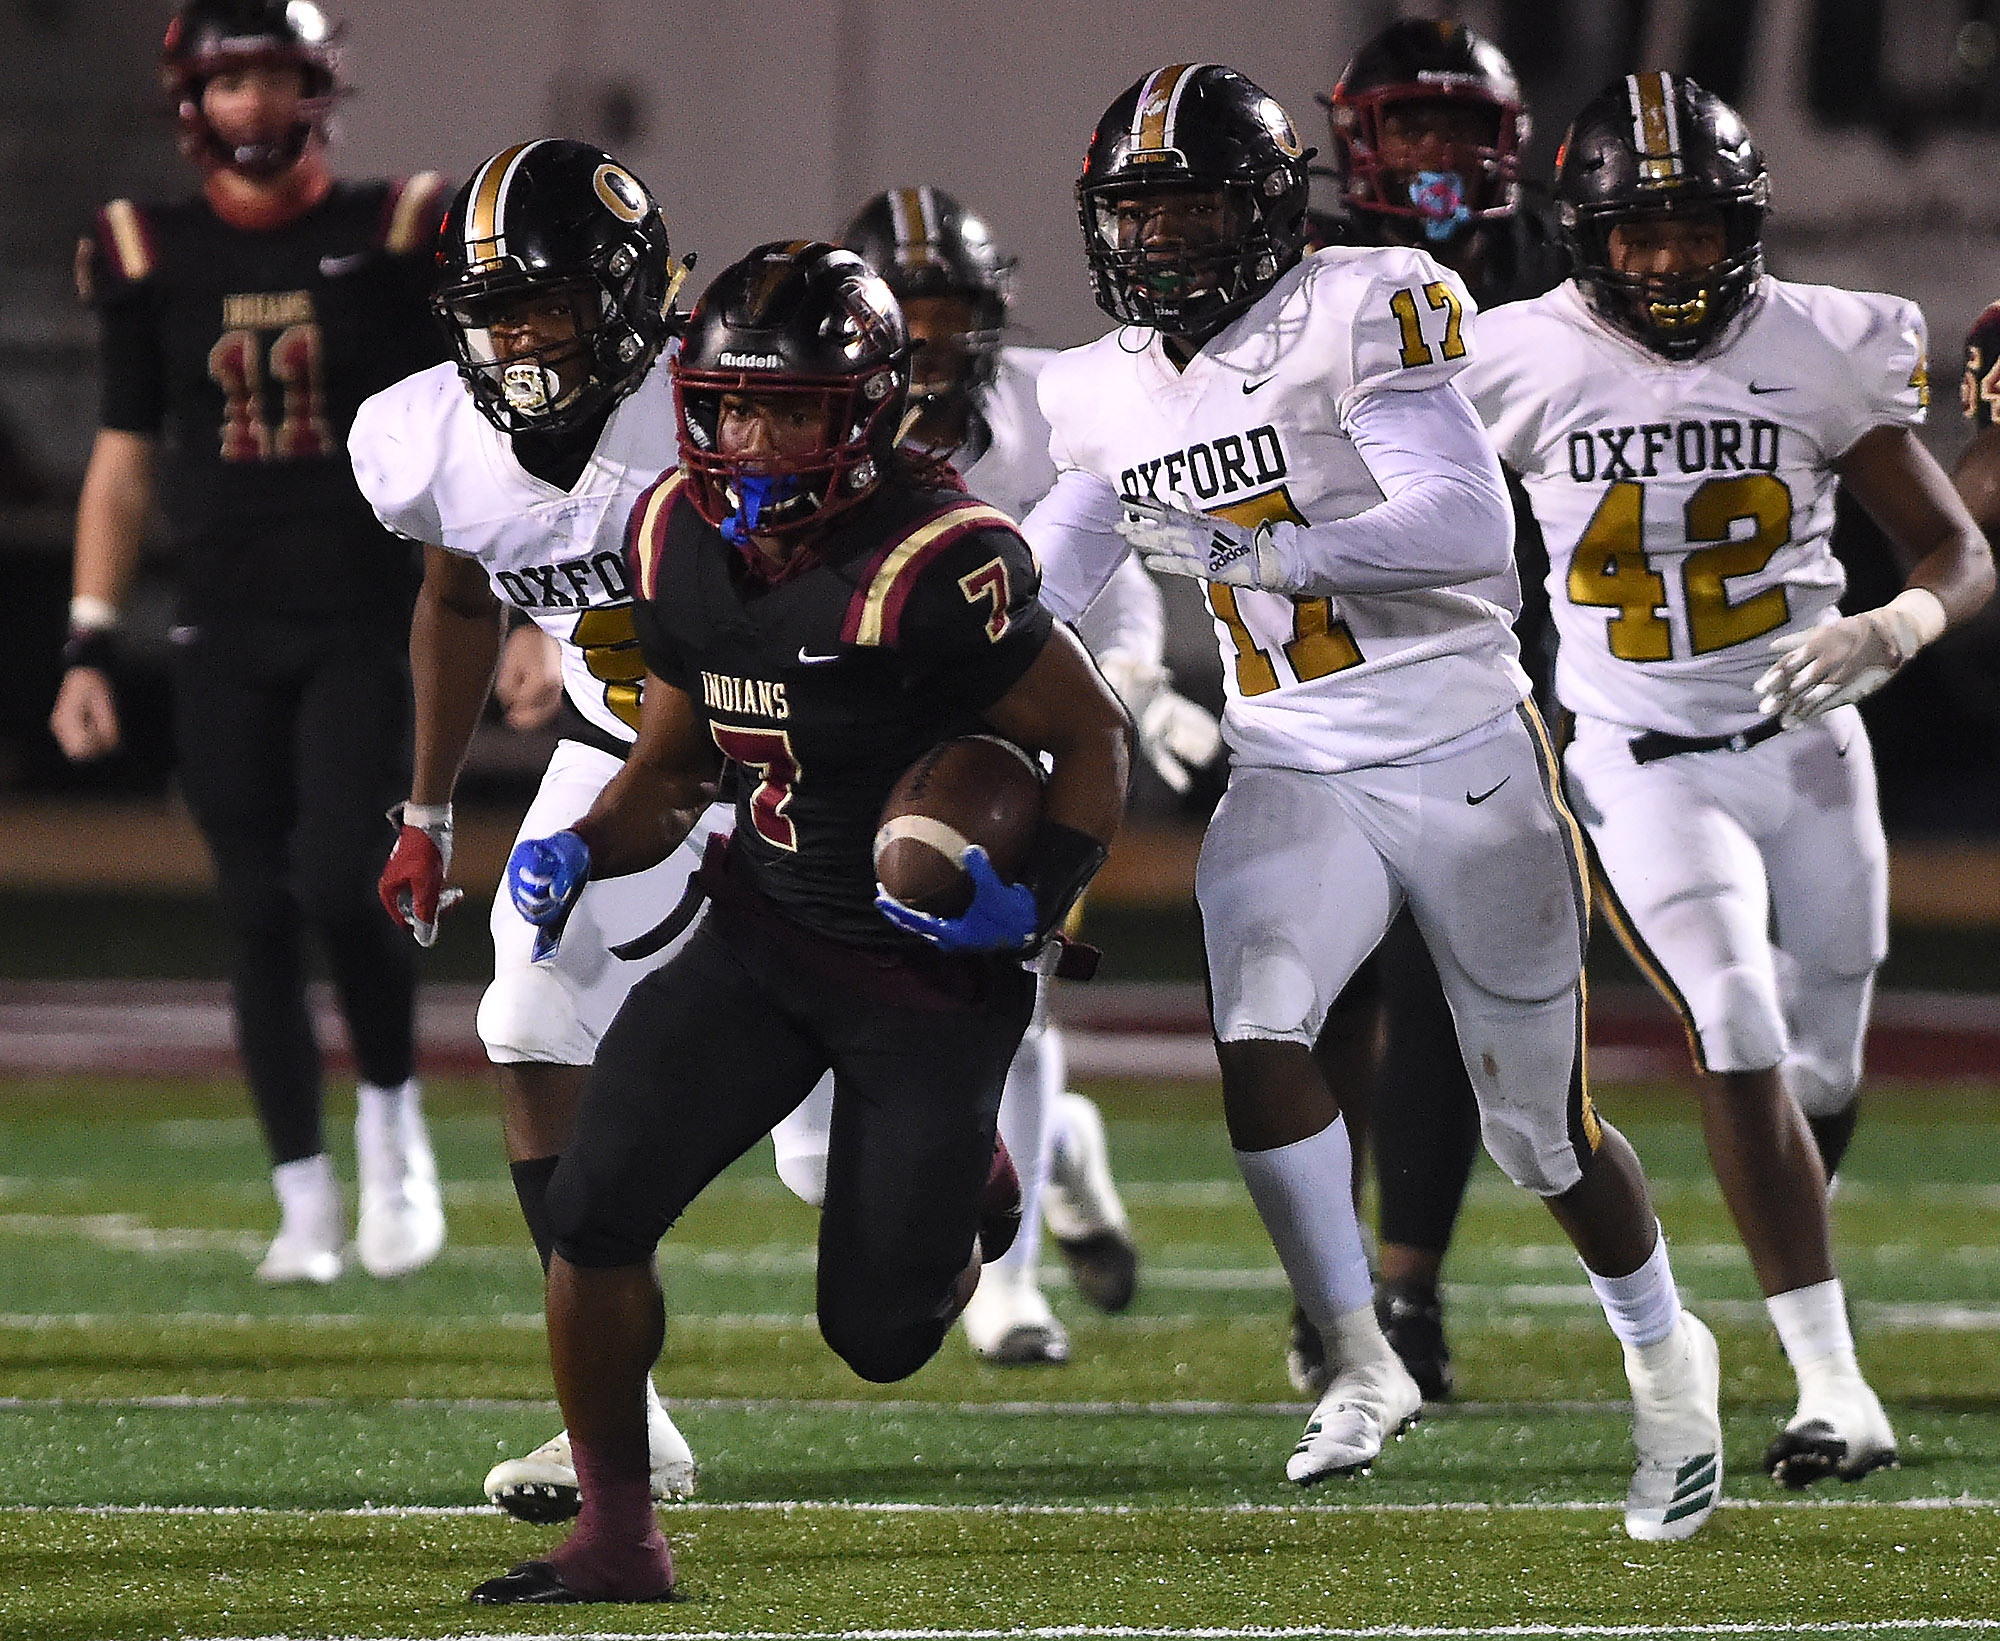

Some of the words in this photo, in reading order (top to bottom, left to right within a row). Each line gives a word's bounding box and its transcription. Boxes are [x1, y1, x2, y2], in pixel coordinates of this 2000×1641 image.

[719, 352, 779, 369] Riddell
[1388, 280, 1467, 368] 17
[208, 324, 340, 461] 11
[1567, 419, 1780, 483] OXFORD
[495, 550, 636, 607] OXFO
[1208, 544, 1252, 572] adidas
[1565, 473, 1794, 662] 42
[957, 555, 1011, 644] 7
[700, 670, 792, 719] INDIANS
[708, 717, 803, 854] 7
